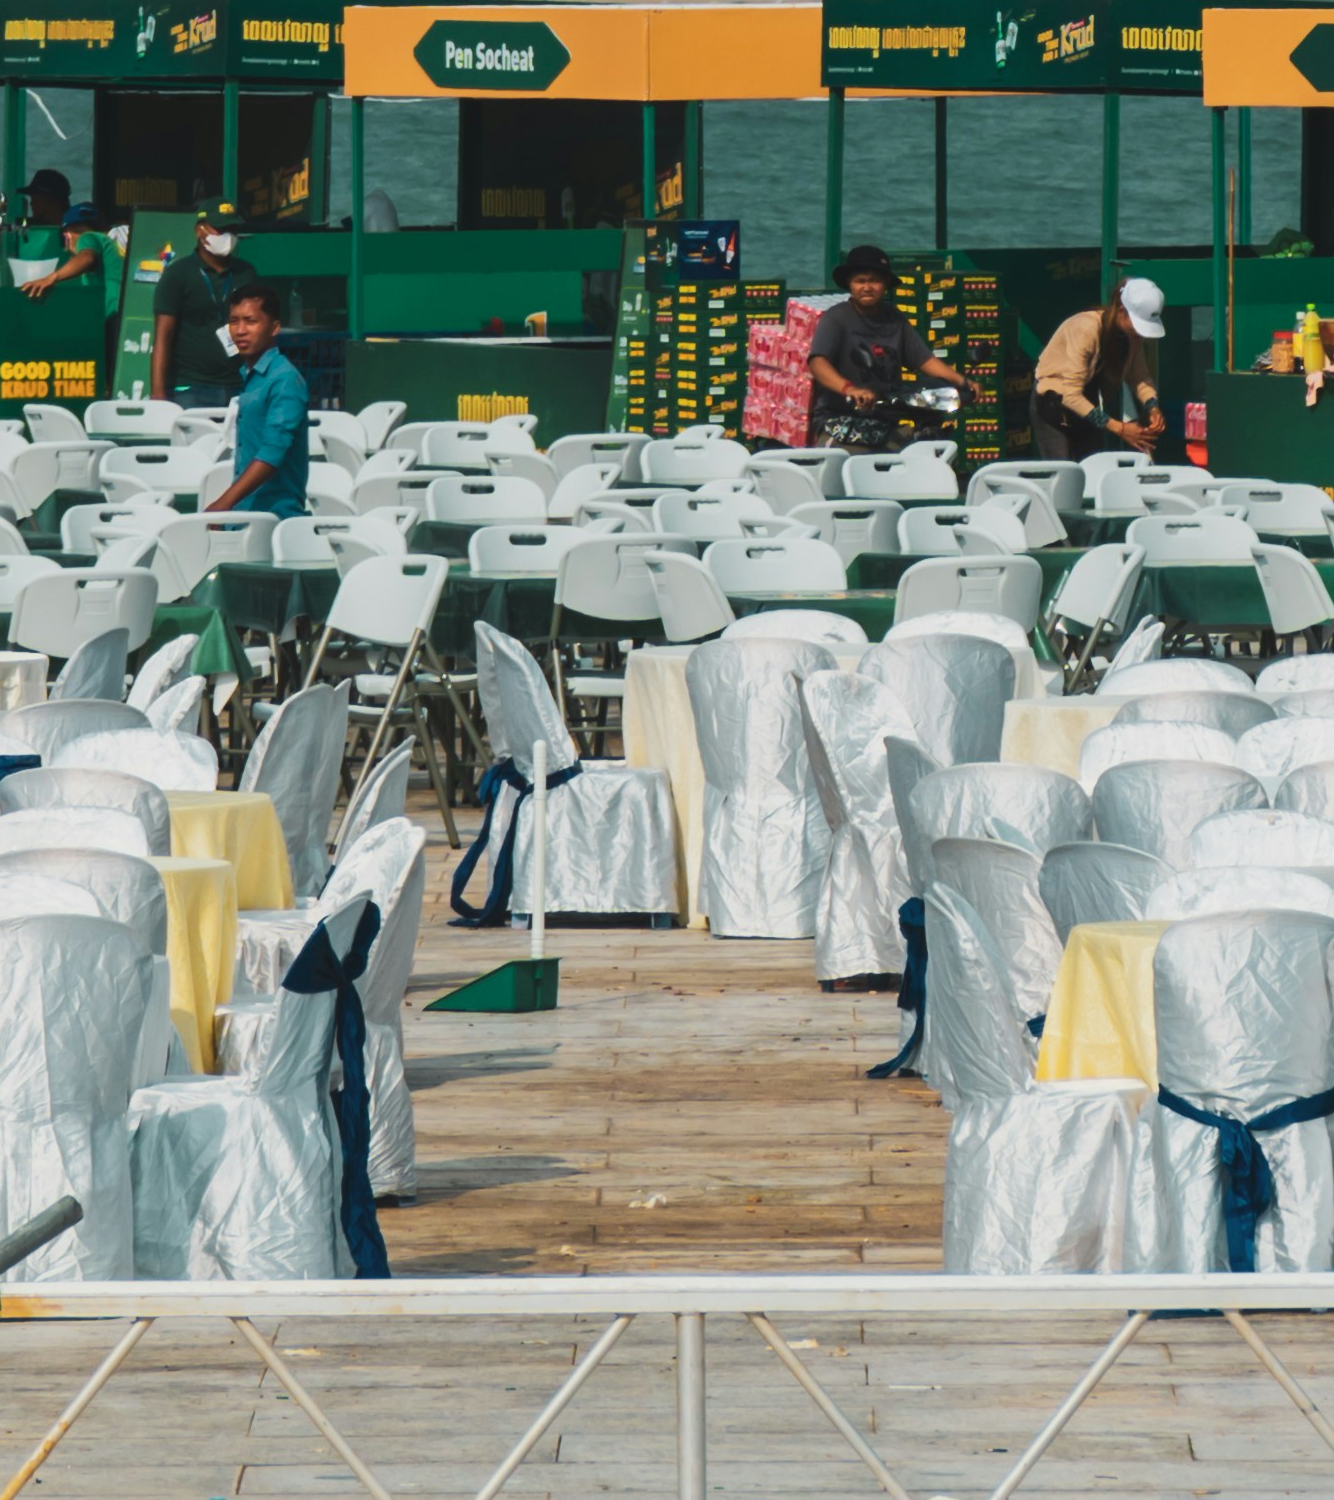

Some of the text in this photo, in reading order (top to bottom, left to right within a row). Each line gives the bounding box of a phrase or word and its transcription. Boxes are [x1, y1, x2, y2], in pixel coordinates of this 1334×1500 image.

[1060, 15, 1095, 58] Krud
[445, 40, 535, 72] Pen Socheat
[0, 361, 96, 380] GOOD TIME
[0, 380, 95, 399] KRUD TIME
